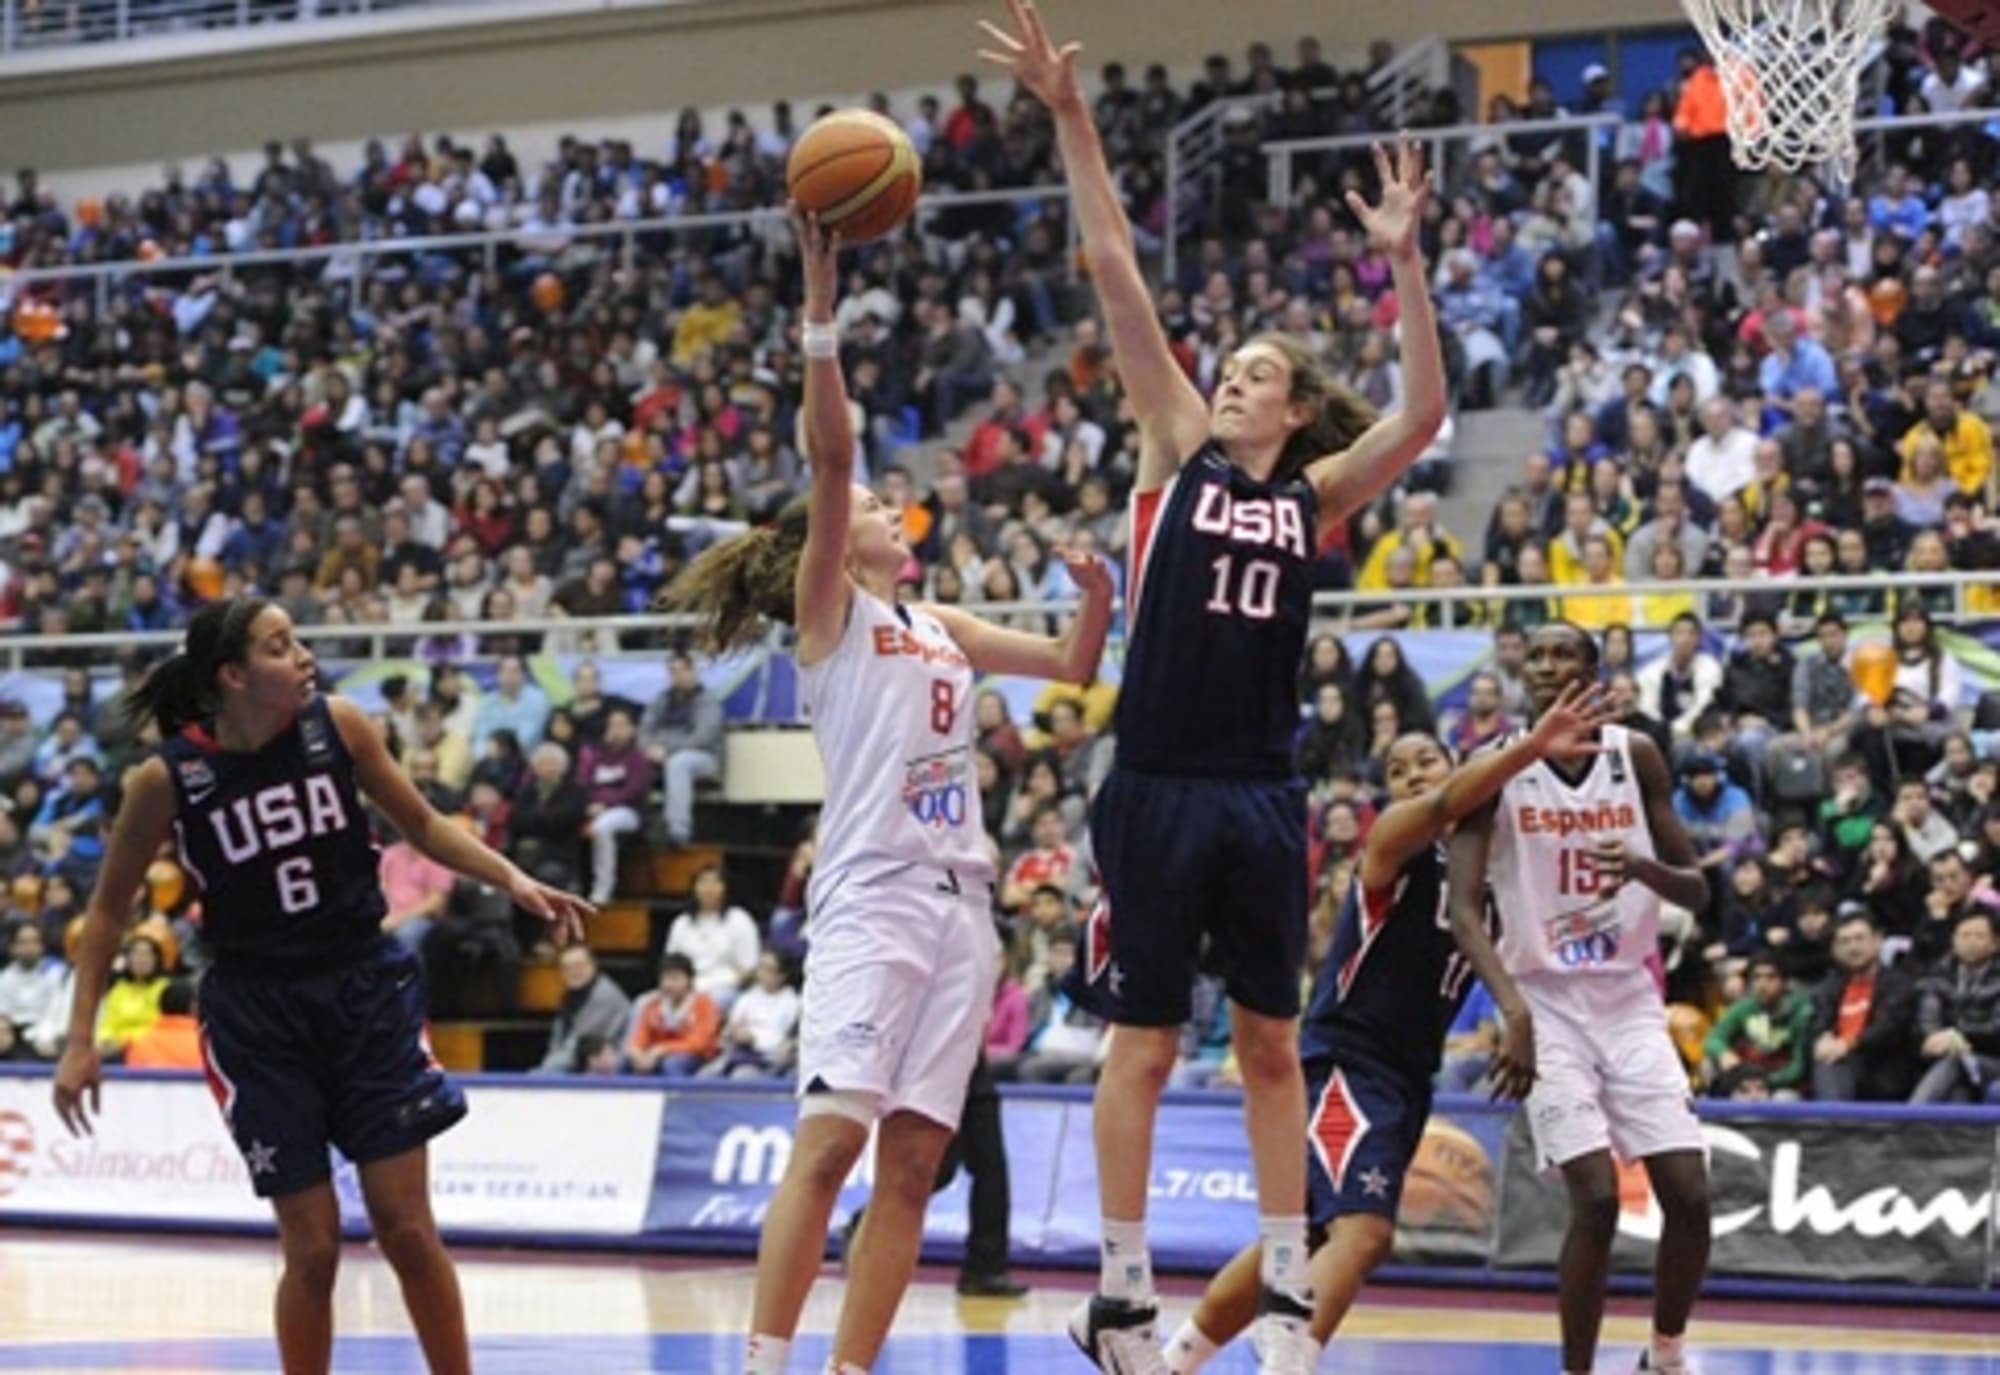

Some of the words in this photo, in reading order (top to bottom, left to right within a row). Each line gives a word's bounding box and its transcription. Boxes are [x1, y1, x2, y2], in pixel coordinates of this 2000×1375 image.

[1192, 483, 1306, 557] USA
[1206, 554, 1281, 619] 10
[930, 677, 955, 735] 8
[209, 773, 348, 864] USA
[1517, 803, 1635, 837] España
[275, 855, 321, 913] 6
[1558, 847, 1606, 895] 15
